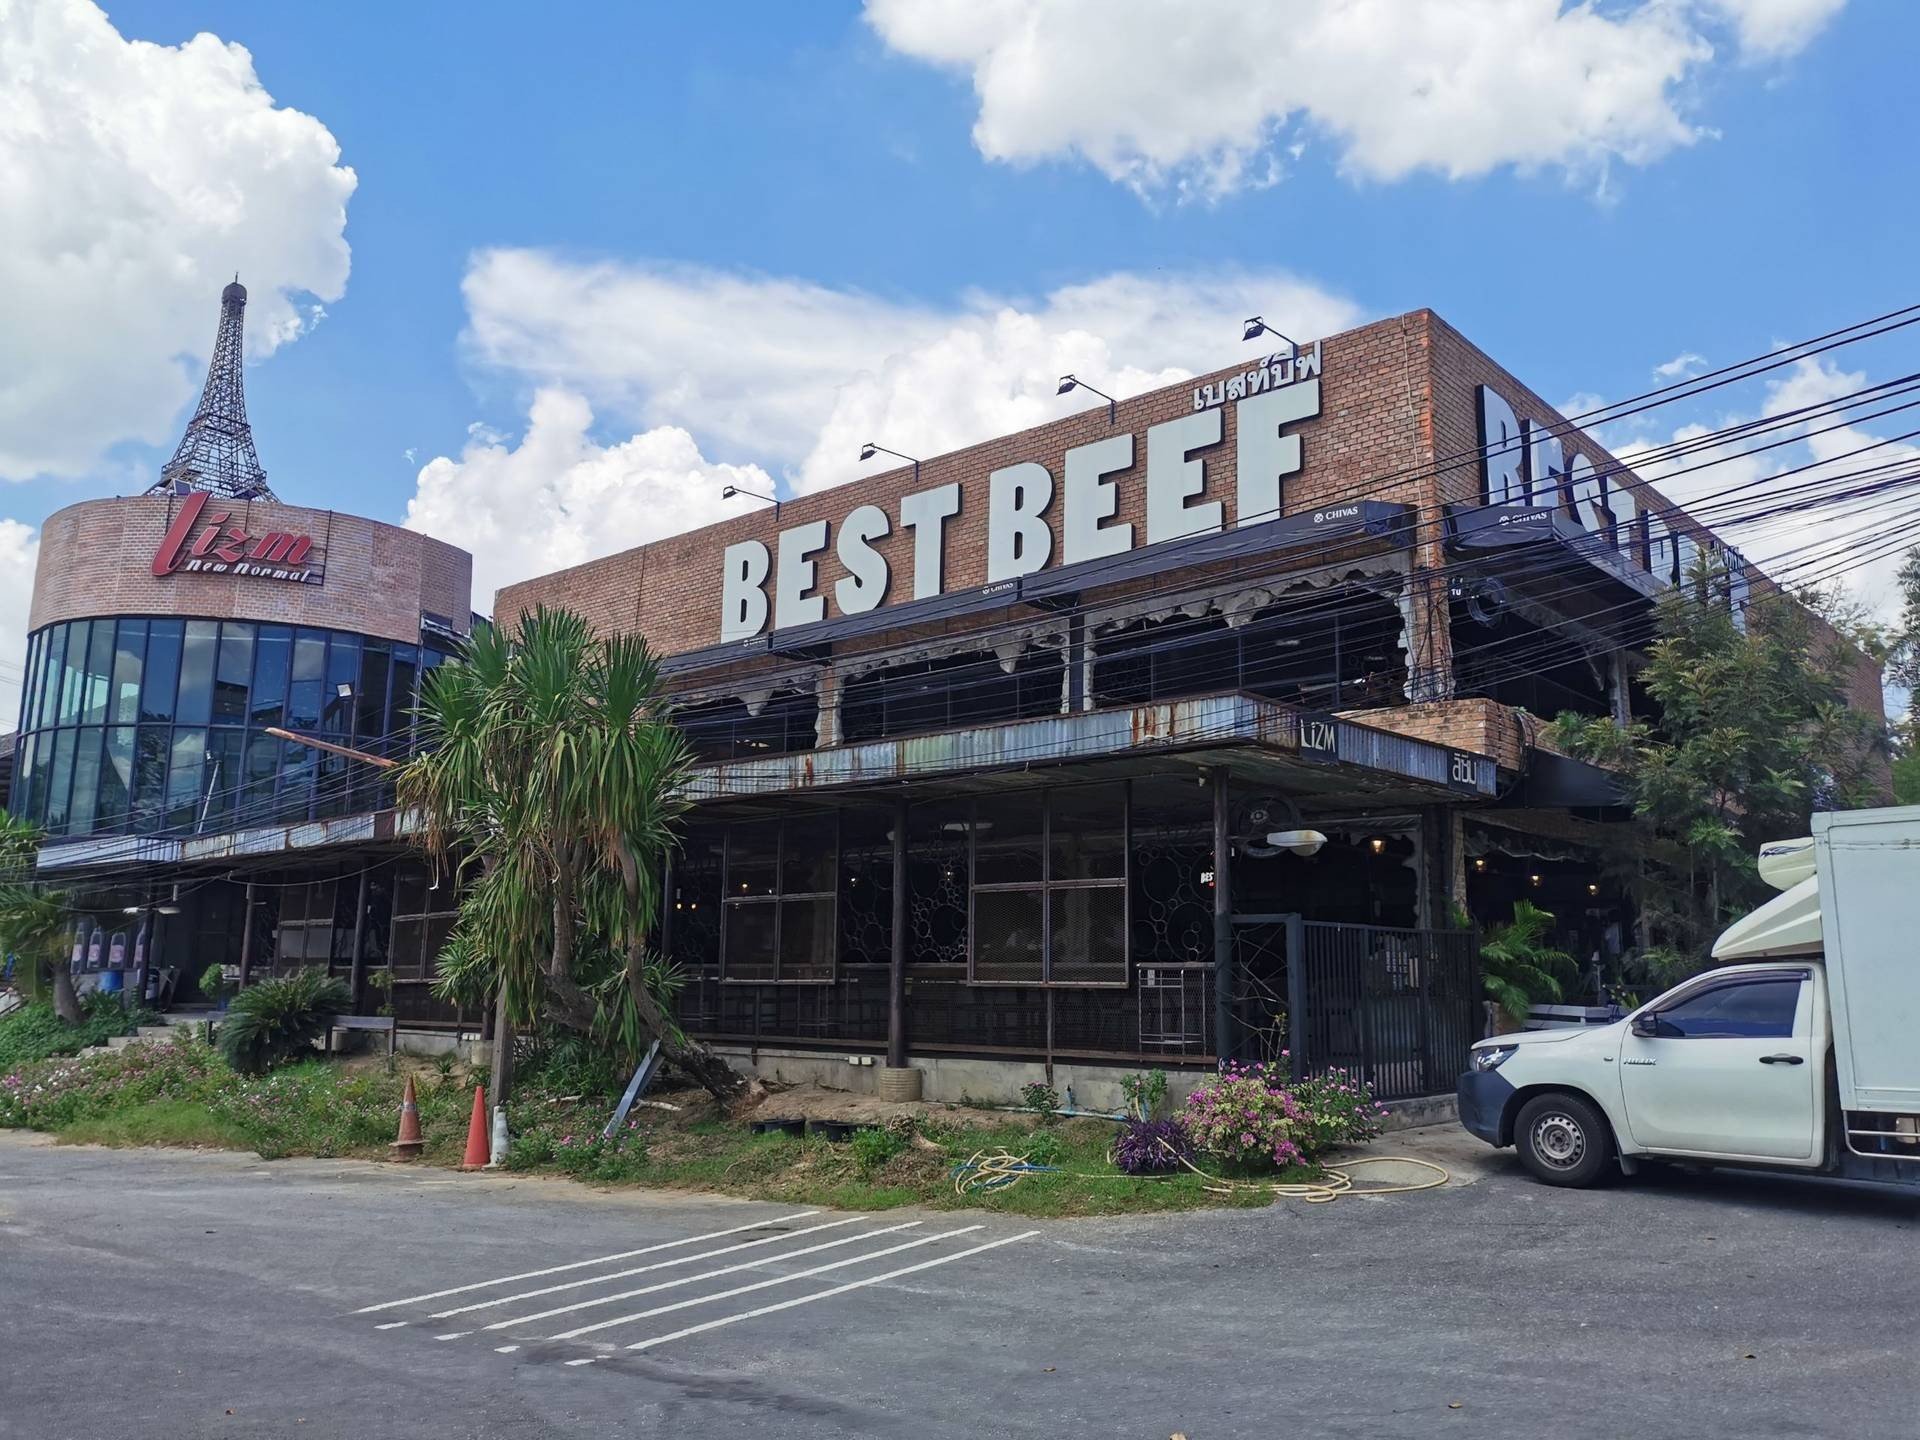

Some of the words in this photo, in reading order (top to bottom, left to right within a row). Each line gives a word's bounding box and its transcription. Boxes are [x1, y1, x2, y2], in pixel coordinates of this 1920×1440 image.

[1194, 340, 1322, 411] เบสท์บีฟ
[720, 482, 962, 645] BEST
[987, 378, 1323, 584] BEEF
[1325, 506, 1359, 520] CHIVAS
